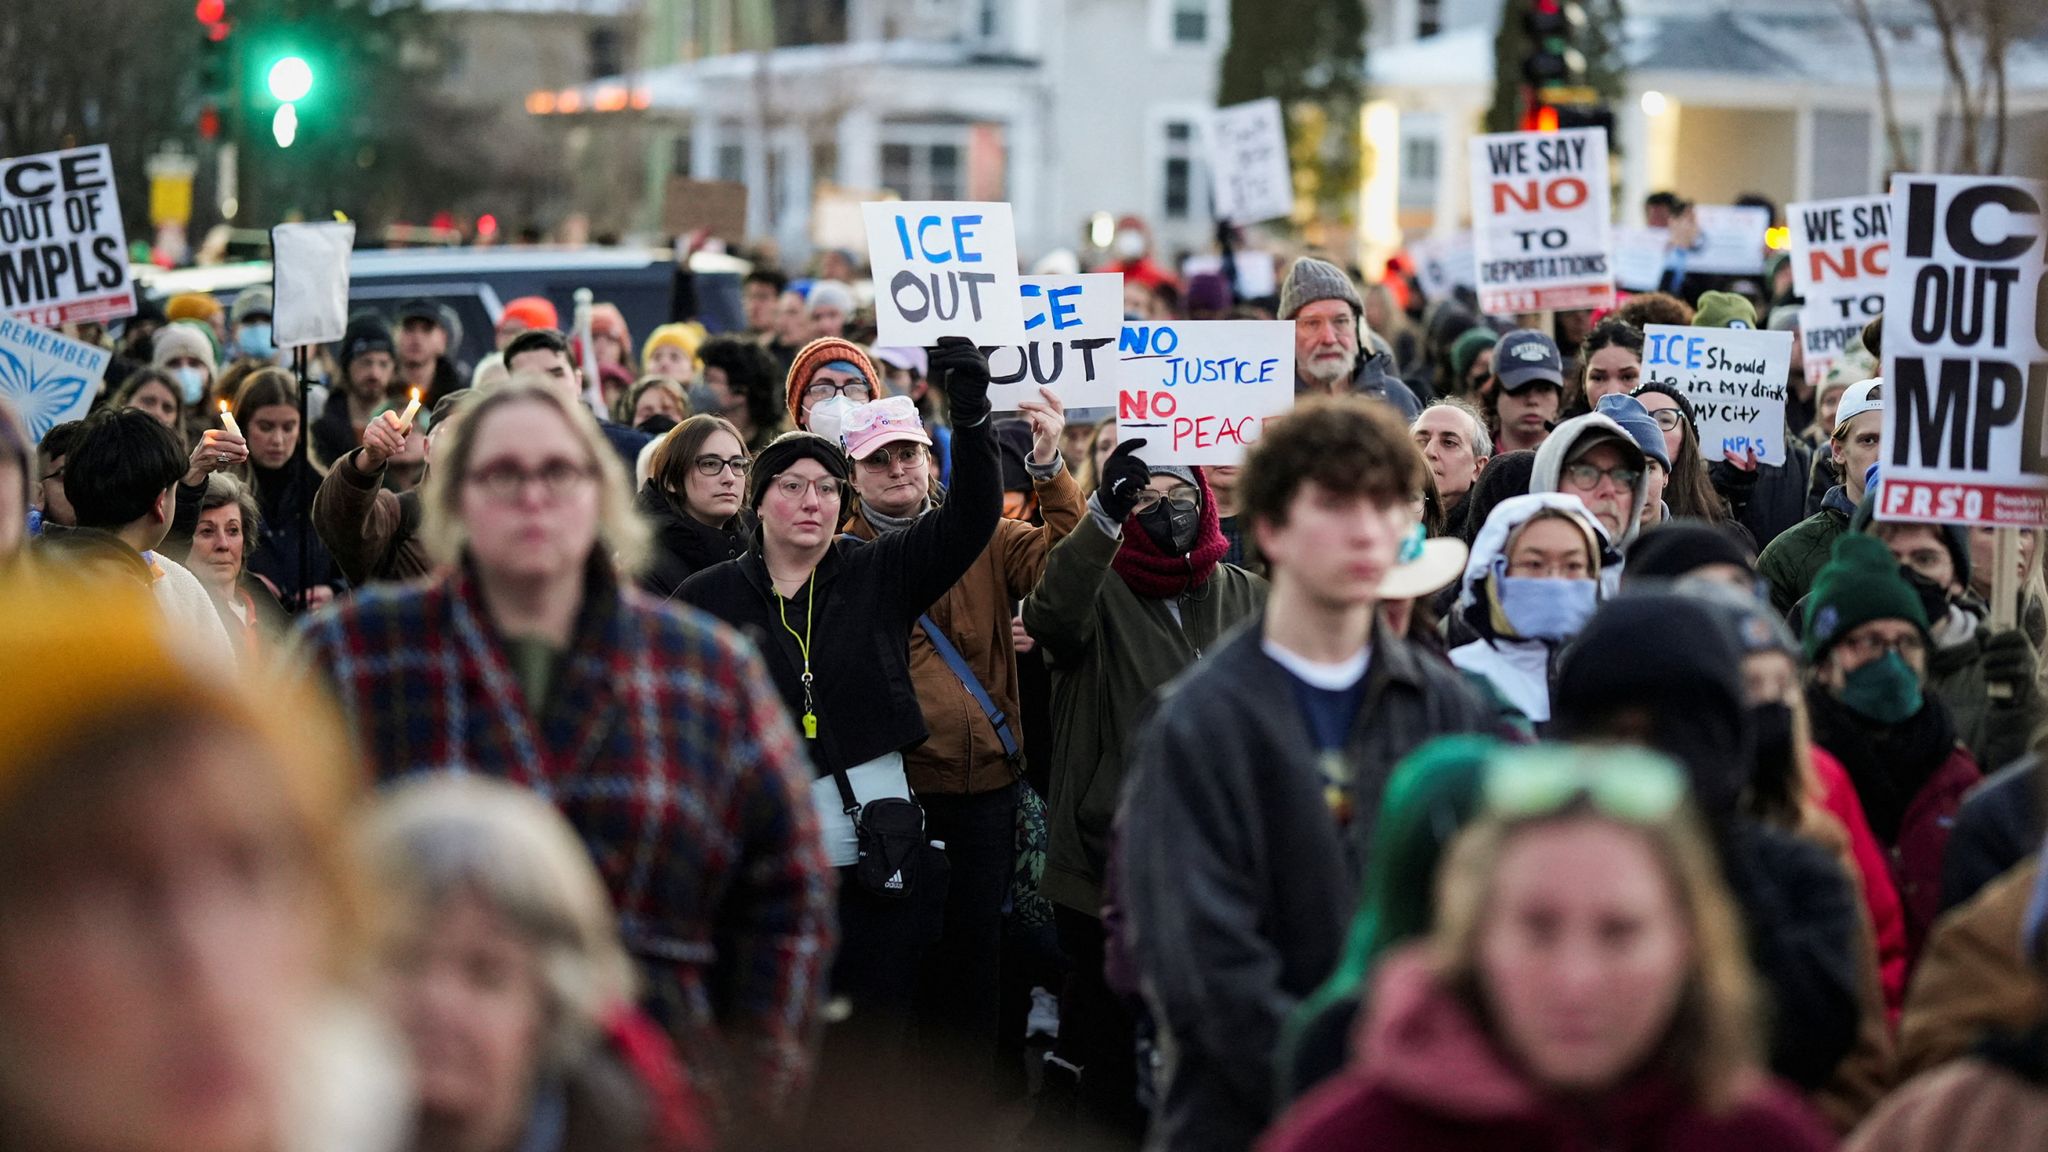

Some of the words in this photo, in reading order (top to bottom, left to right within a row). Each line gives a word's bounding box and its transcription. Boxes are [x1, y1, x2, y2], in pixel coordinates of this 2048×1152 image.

[4, 153, 107, 198] CE
[1488, 141, 1529, 175] WE
[1537, 138, 1586, 172] SAY
[1491, 176, 1589, 215] NO
[0, 200, 54, 243] OUT
[65, 193, 102, 234] OF
[1804, 208, 1845, 243] WE
[1853, 204, 1892, 239] SA
[1906, 182, 2048, 262] IC
[895, 214, 983, 264] ICE
[1513, 228, 1568, 250] TO
[0, 236, 123, 307] MPLS
[890, 270, 996, 323] OUT
[1020, 284, 1084, 330] CE
[1832, 295, 1885, 319] TO
[1911, 264, 2020, 348] OUT
[0, 319, 101, 372] REMEMBER
[1118, 326, 1178, 354] NO
[1647, 333, 1705, 369] ICE
[978, 337, 1116, 385] OUT
[1162, 357, 1280, 386] JUSTICE
[1687, 374, 1713, 393] in
[1119, 389, 1177, 419] NO
[1892, 357, 2048, 475] MPL
[1173, 415, 1286, 452] PEAC
[1886, 484, 1984, 520] FRSO
